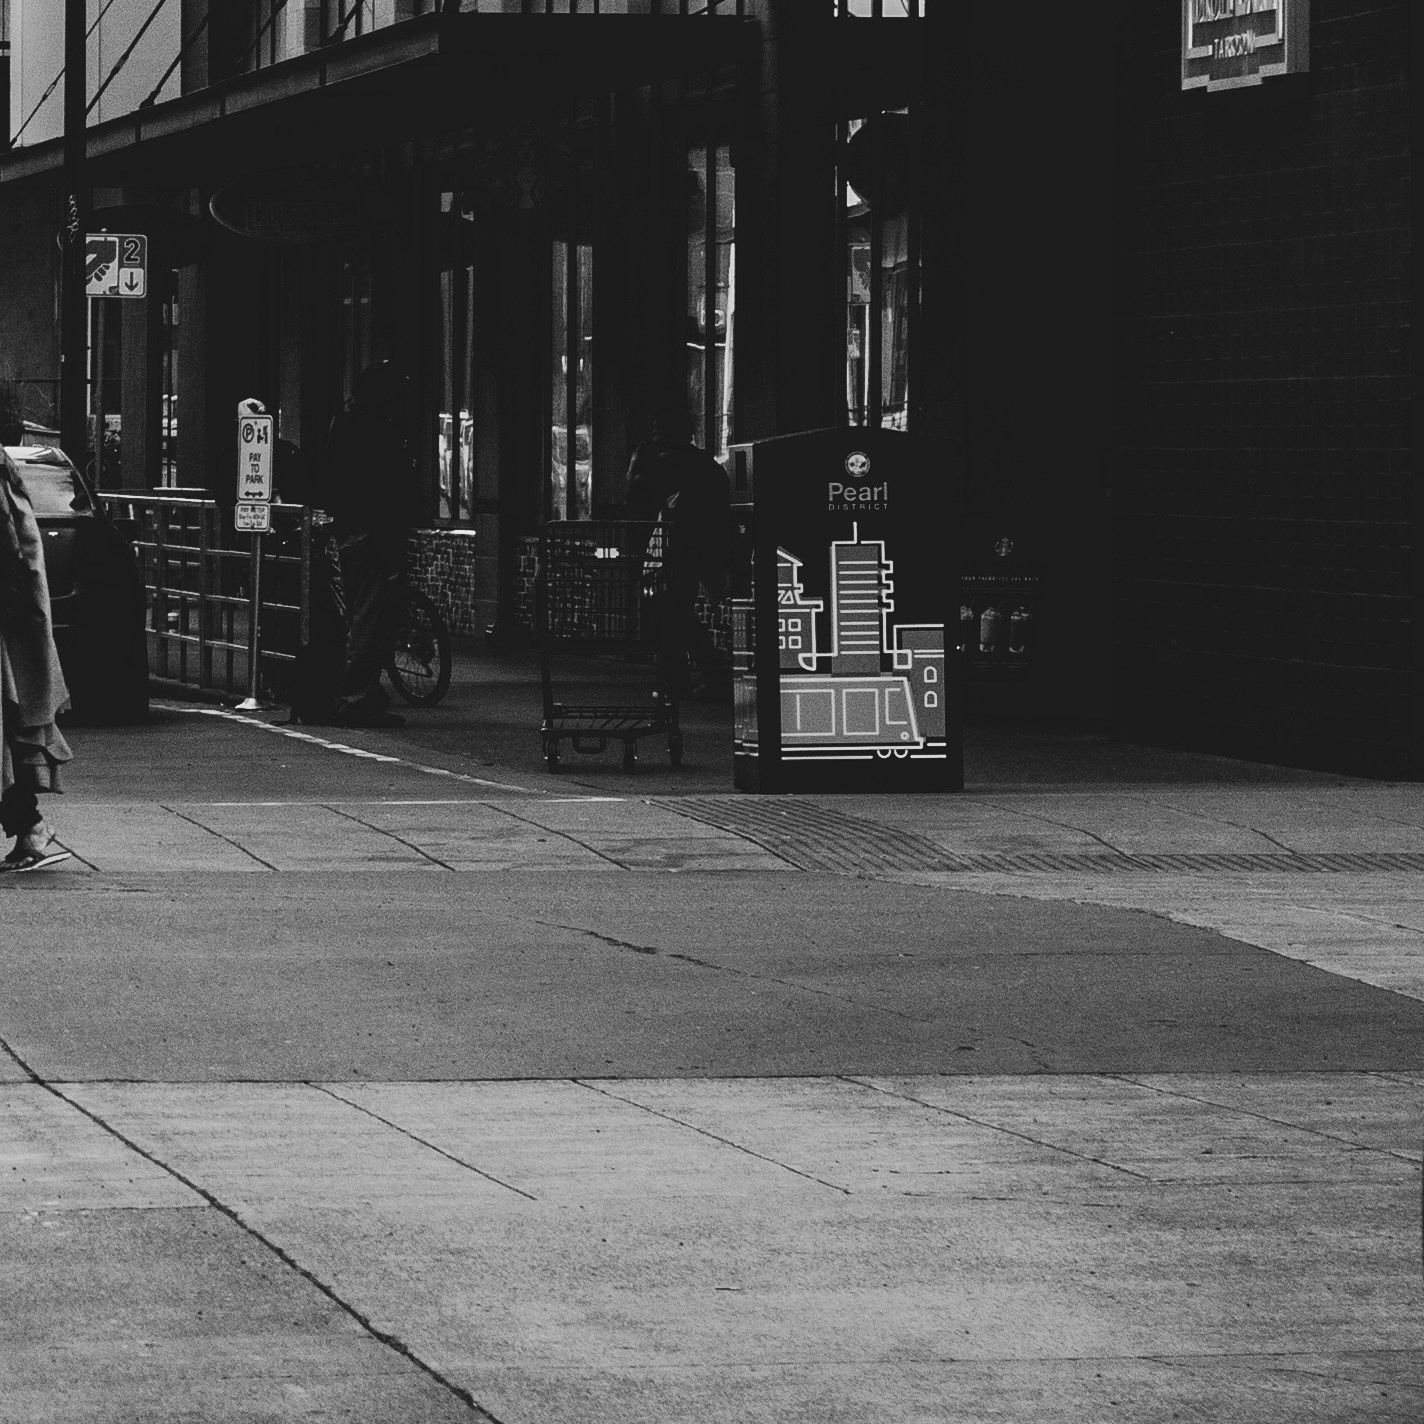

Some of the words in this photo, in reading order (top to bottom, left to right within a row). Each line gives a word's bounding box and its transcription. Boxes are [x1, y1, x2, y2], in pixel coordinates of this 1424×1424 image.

[124, 238, 140, 263] 2
[249, 453, 261, 462] PAY
[251, 464, 260, 473] TO
[245, 475, 263, 484] PARK
[828, 481, 888, 501] Pearl
